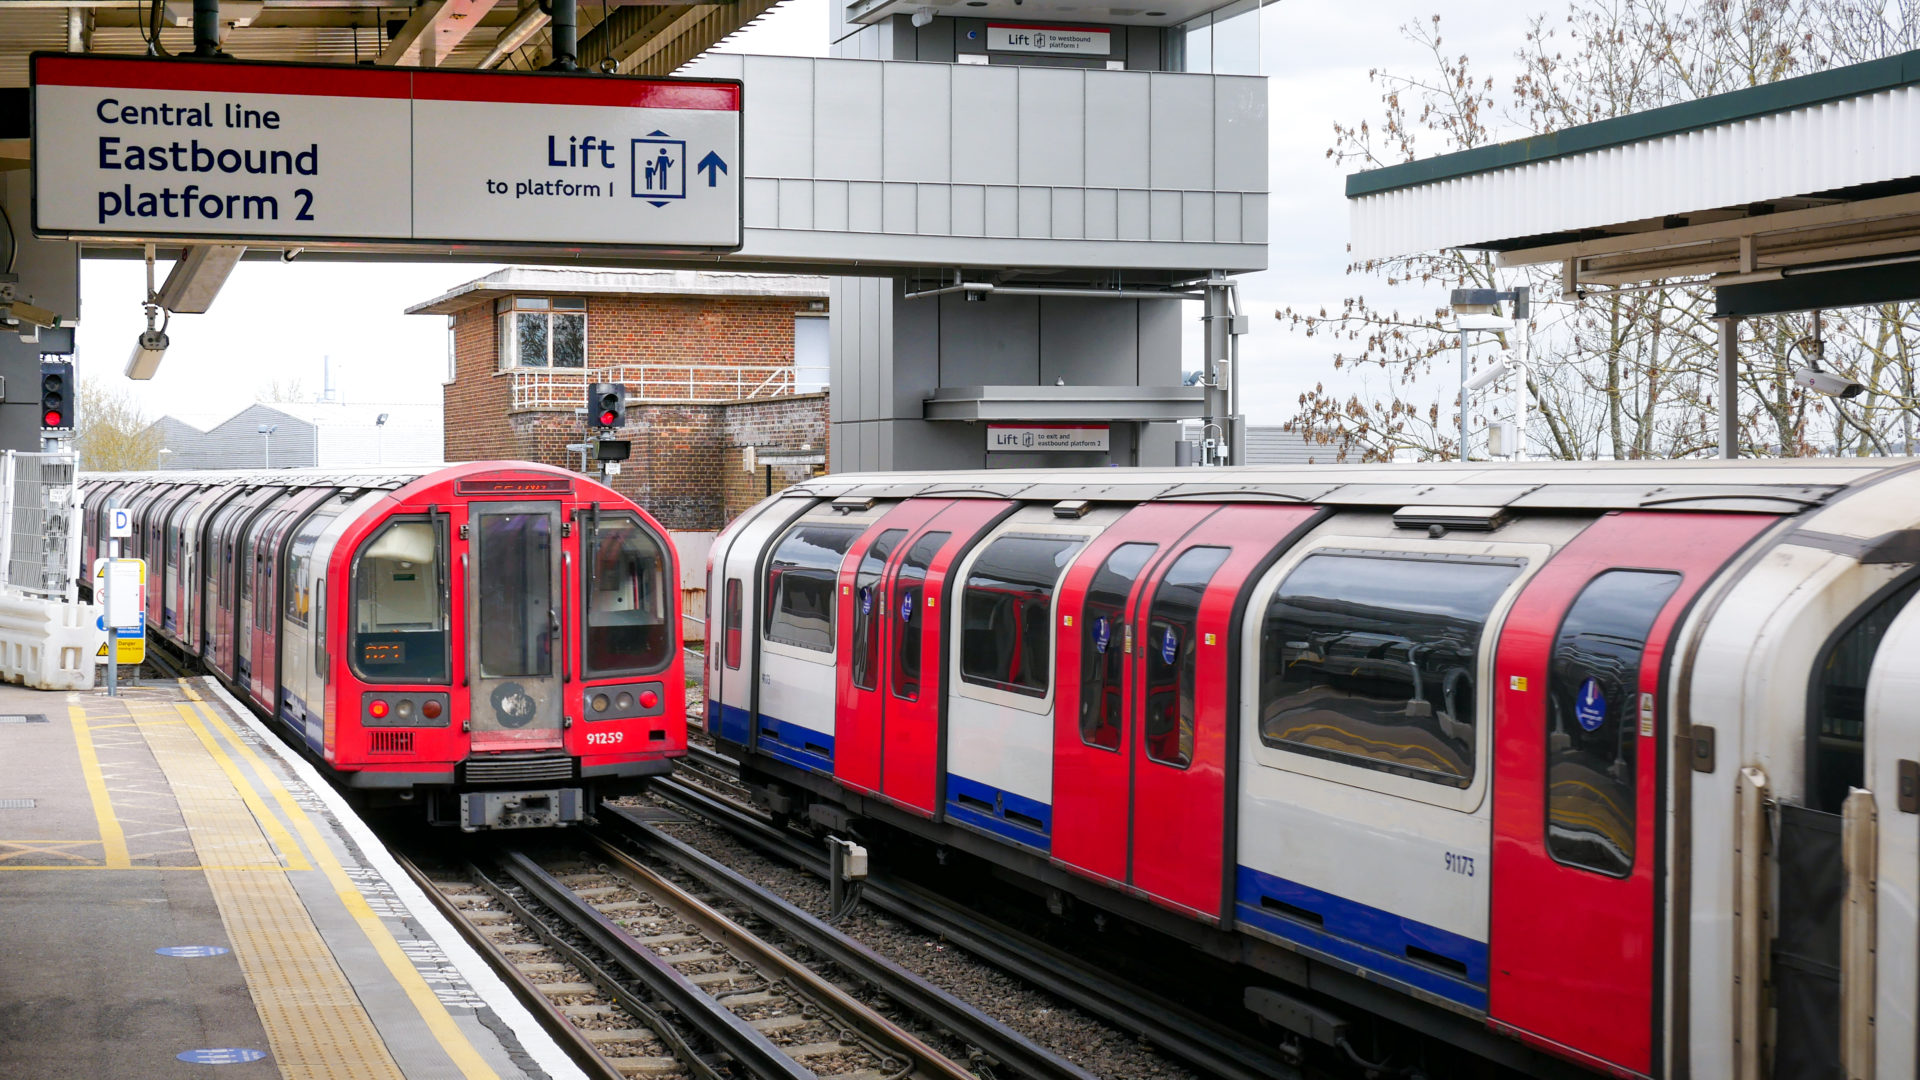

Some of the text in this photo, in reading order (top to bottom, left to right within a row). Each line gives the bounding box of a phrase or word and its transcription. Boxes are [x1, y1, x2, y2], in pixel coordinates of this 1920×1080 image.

[1008, 34, 1030, 46] Lift
[96, 98, 281, 130] Central line
[99, 136, 318, 176] Eastbound
[548, 135, 615, 169] Lift
[486, 179, 508, 194] to
[516, 178, 600, 199] platform
[98, 184, 315, 225] platform 2
[997, 434, 1018, 445] Lift
[116, 511, 127, 529] D
[586, 732, 624, 745] 91259
[1445, 851, 1475, 877] 91173
